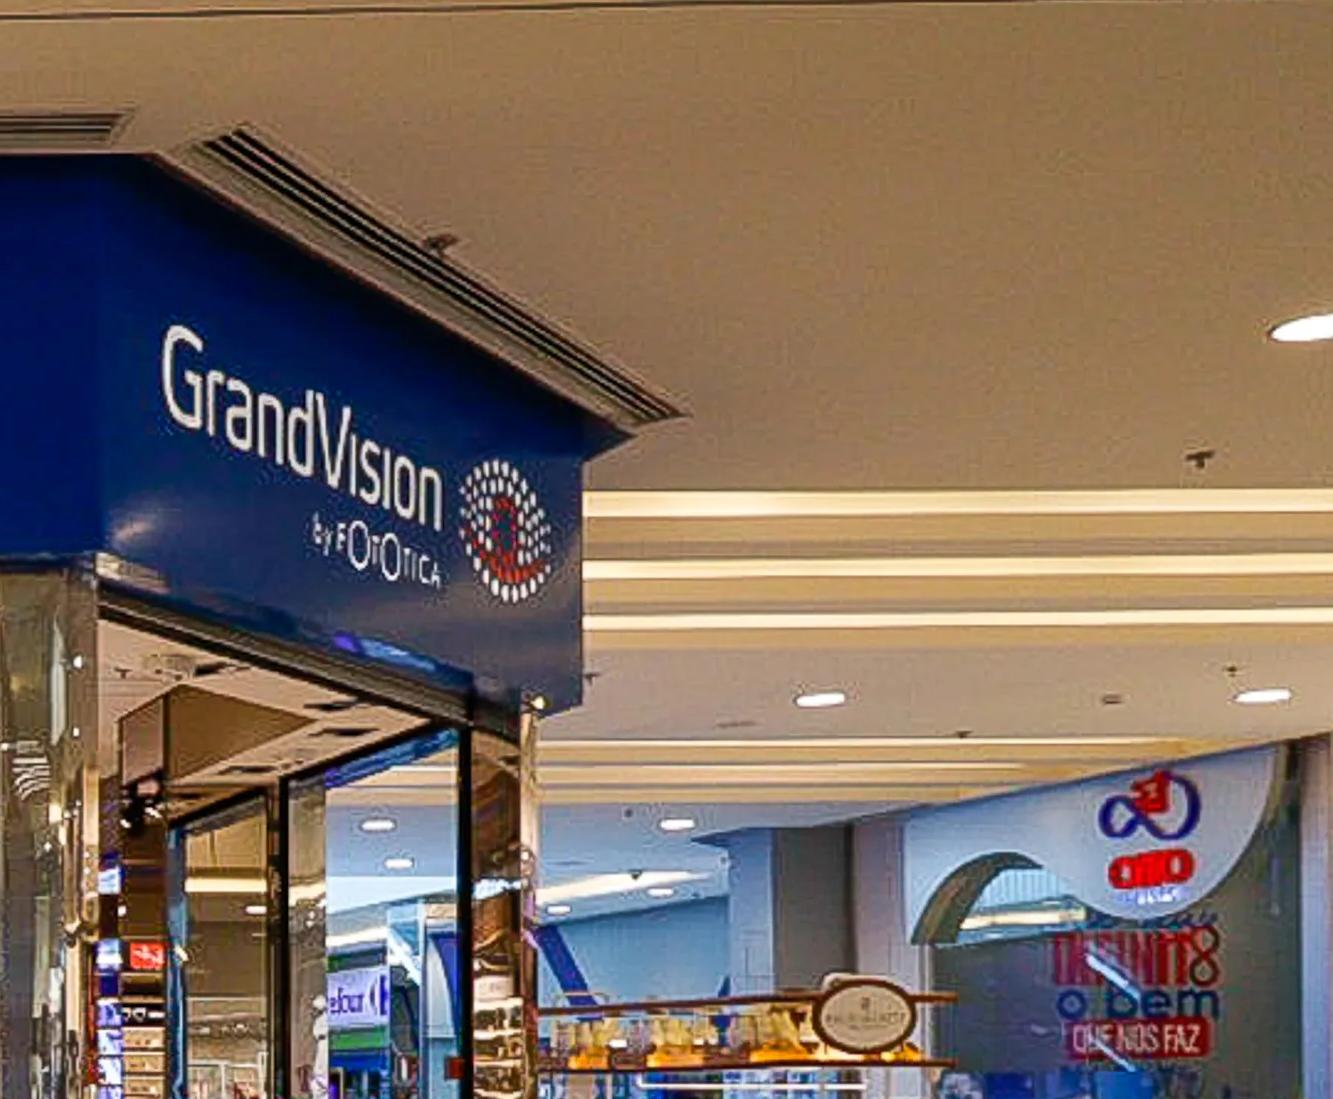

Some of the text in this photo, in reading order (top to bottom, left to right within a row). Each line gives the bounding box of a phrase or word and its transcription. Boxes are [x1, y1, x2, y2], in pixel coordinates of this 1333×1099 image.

[161, 323, 444, 532] GrandVision
[312, 512, 442, 589] by FOTOTICA
[1164, 1023, 1202, 1054] FAZ
